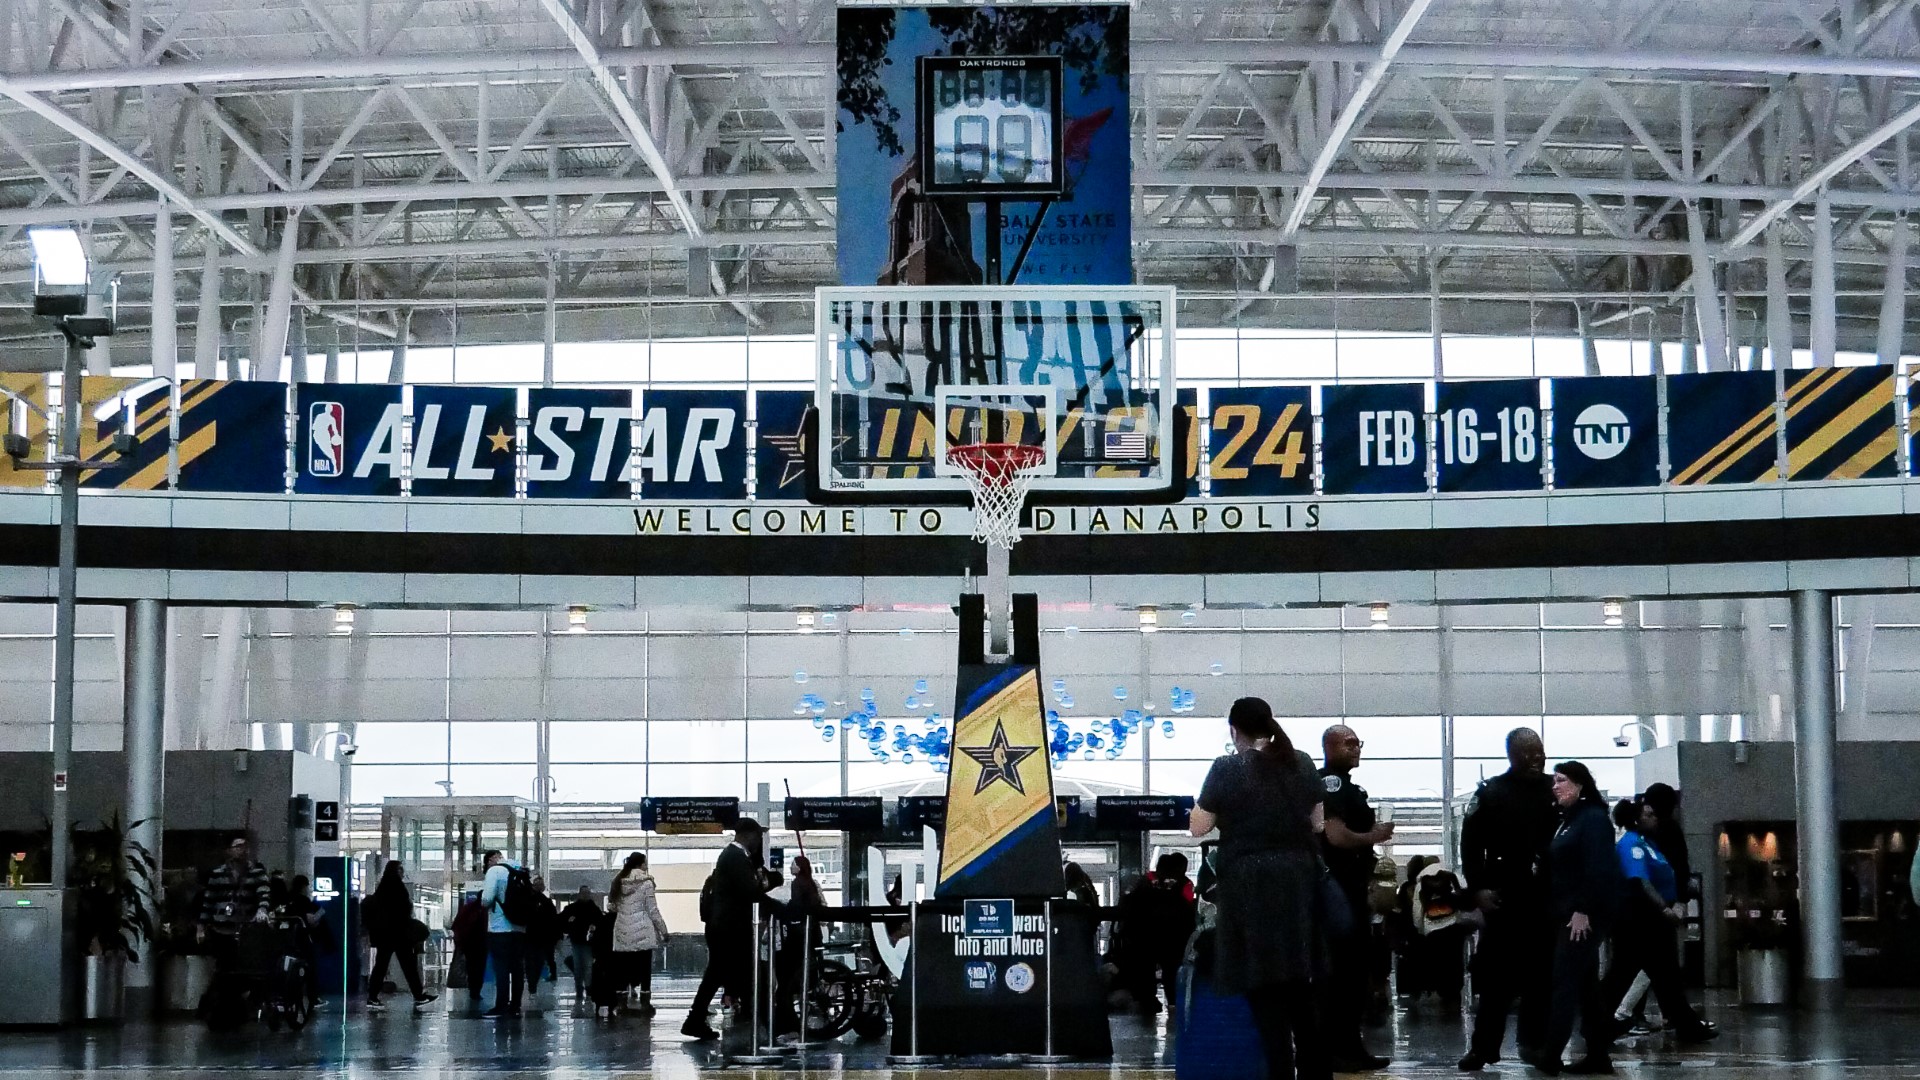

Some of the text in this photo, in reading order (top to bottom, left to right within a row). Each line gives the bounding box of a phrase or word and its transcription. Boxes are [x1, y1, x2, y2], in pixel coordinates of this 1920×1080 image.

[1000, 214, 1116, 228] BAL STATE
[1005, 233, 1108, 245] UNVERSITY
[353, 403, 736, 482] ALL STAR
[1359, 406, 1536, 466] FEB 16-18
[314, 459, 330, 471] NBA
[830, 481, 865, 489] SPALDING
[635, 504, 1321, 532] WELCOME TO DIANAPOLIS
[323, 805, 332, 817] 4
[954, 935, 1044, 956] Info and More
